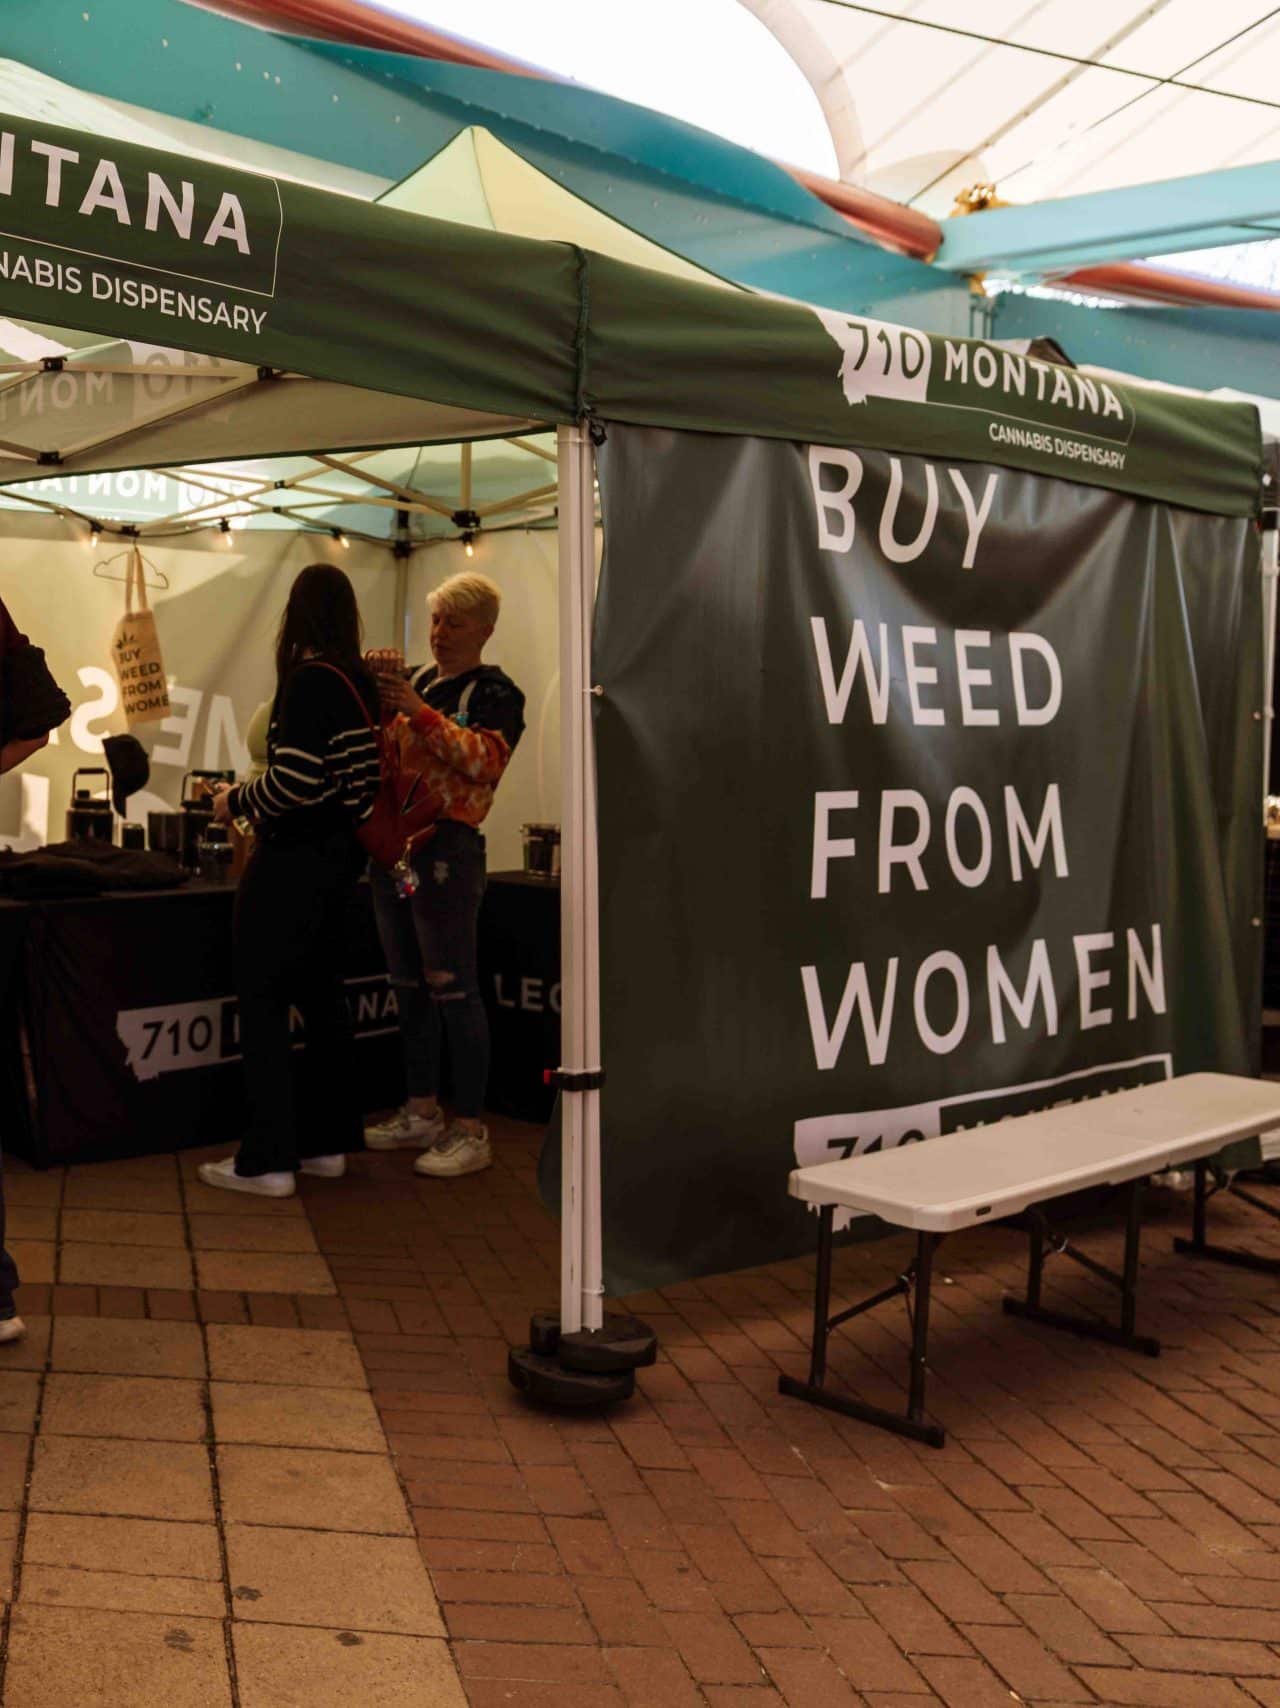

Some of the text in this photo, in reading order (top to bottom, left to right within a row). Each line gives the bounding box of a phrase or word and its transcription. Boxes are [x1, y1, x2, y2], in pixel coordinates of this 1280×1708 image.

[91, 272, 267, 334] DISPENSARY
[847, 322, 1124, 420] 710 MONTANA
[989, 423, 1126, 470] CANNABIS DISPENSARY
[809, 444, 999, 569] BUY
[122, 680, 162, 697] FROM
[126, 694, 169, 714] WOME
[810, 616, 1063, 726] WEED
[810, 783, 1069, 899] FROM
[800, 923, 1167, 1070] WOMEN
[142, 1015, 213, 1060] 710
